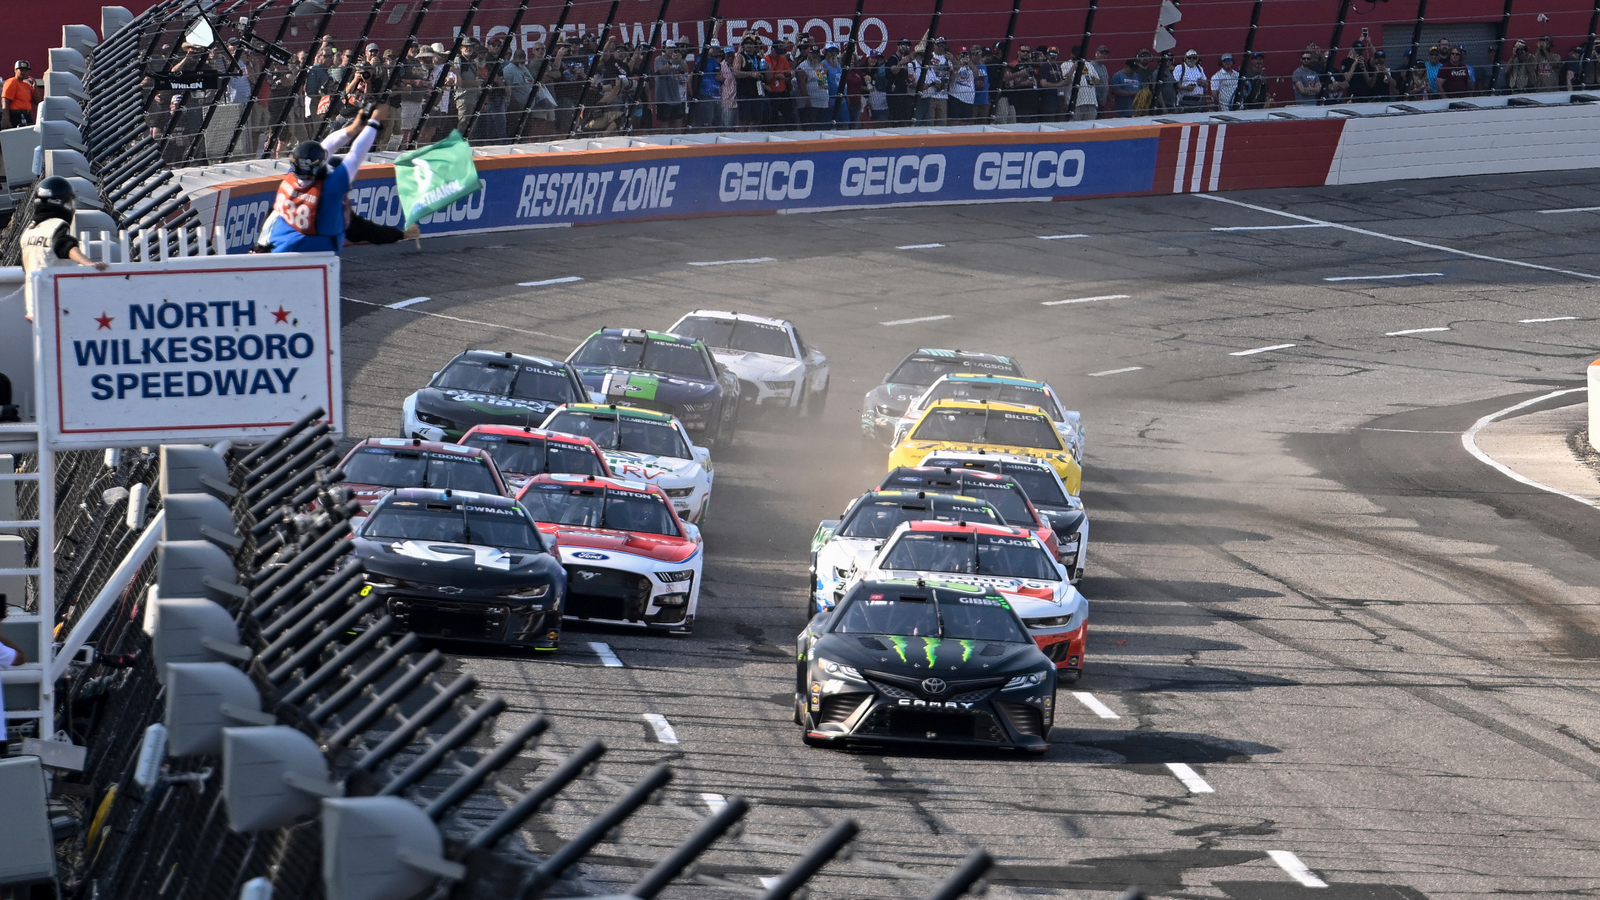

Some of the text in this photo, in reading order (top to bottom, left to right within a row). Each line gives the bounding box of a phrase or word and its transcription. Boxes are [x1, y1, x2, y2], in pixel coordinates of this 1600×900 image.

[839, 154, 947, 197] GEICO
[973, 149, 1085, 191] GEICO
[719, 160, 813, 202] GEICO
[516, 165, 680, 218] RESTART ZONE
[225, 200, 269, 247] GEICO
[129, 300, 256, 330] NORTH
[73, 332, 314, 366] WILKESBORO
[653, 340, 692, 350] NEWMAN
[526, 366, 566, 378] DILLON
[91, 367, 299, 400] SPEEDWAY
[1014, 385, 1043, 393] SMITH
[619, 416, 673, 427] ALLMENDINGE
[1004, 413, 1039, 422] BILICK
[547, 442, 586, 452] PREECE
[993, 463, 1044, 473] AMIROLA
[607, 490, 651, 500] BURTON
[456, 504, 514, 516] BOWMAN
[952, 505, 987, 514] HALEY
[578, 551, 602, 560] Ford
[959, 597, 1001, 607] GIBBS
[898, 699, 974, 709] CAMRY
